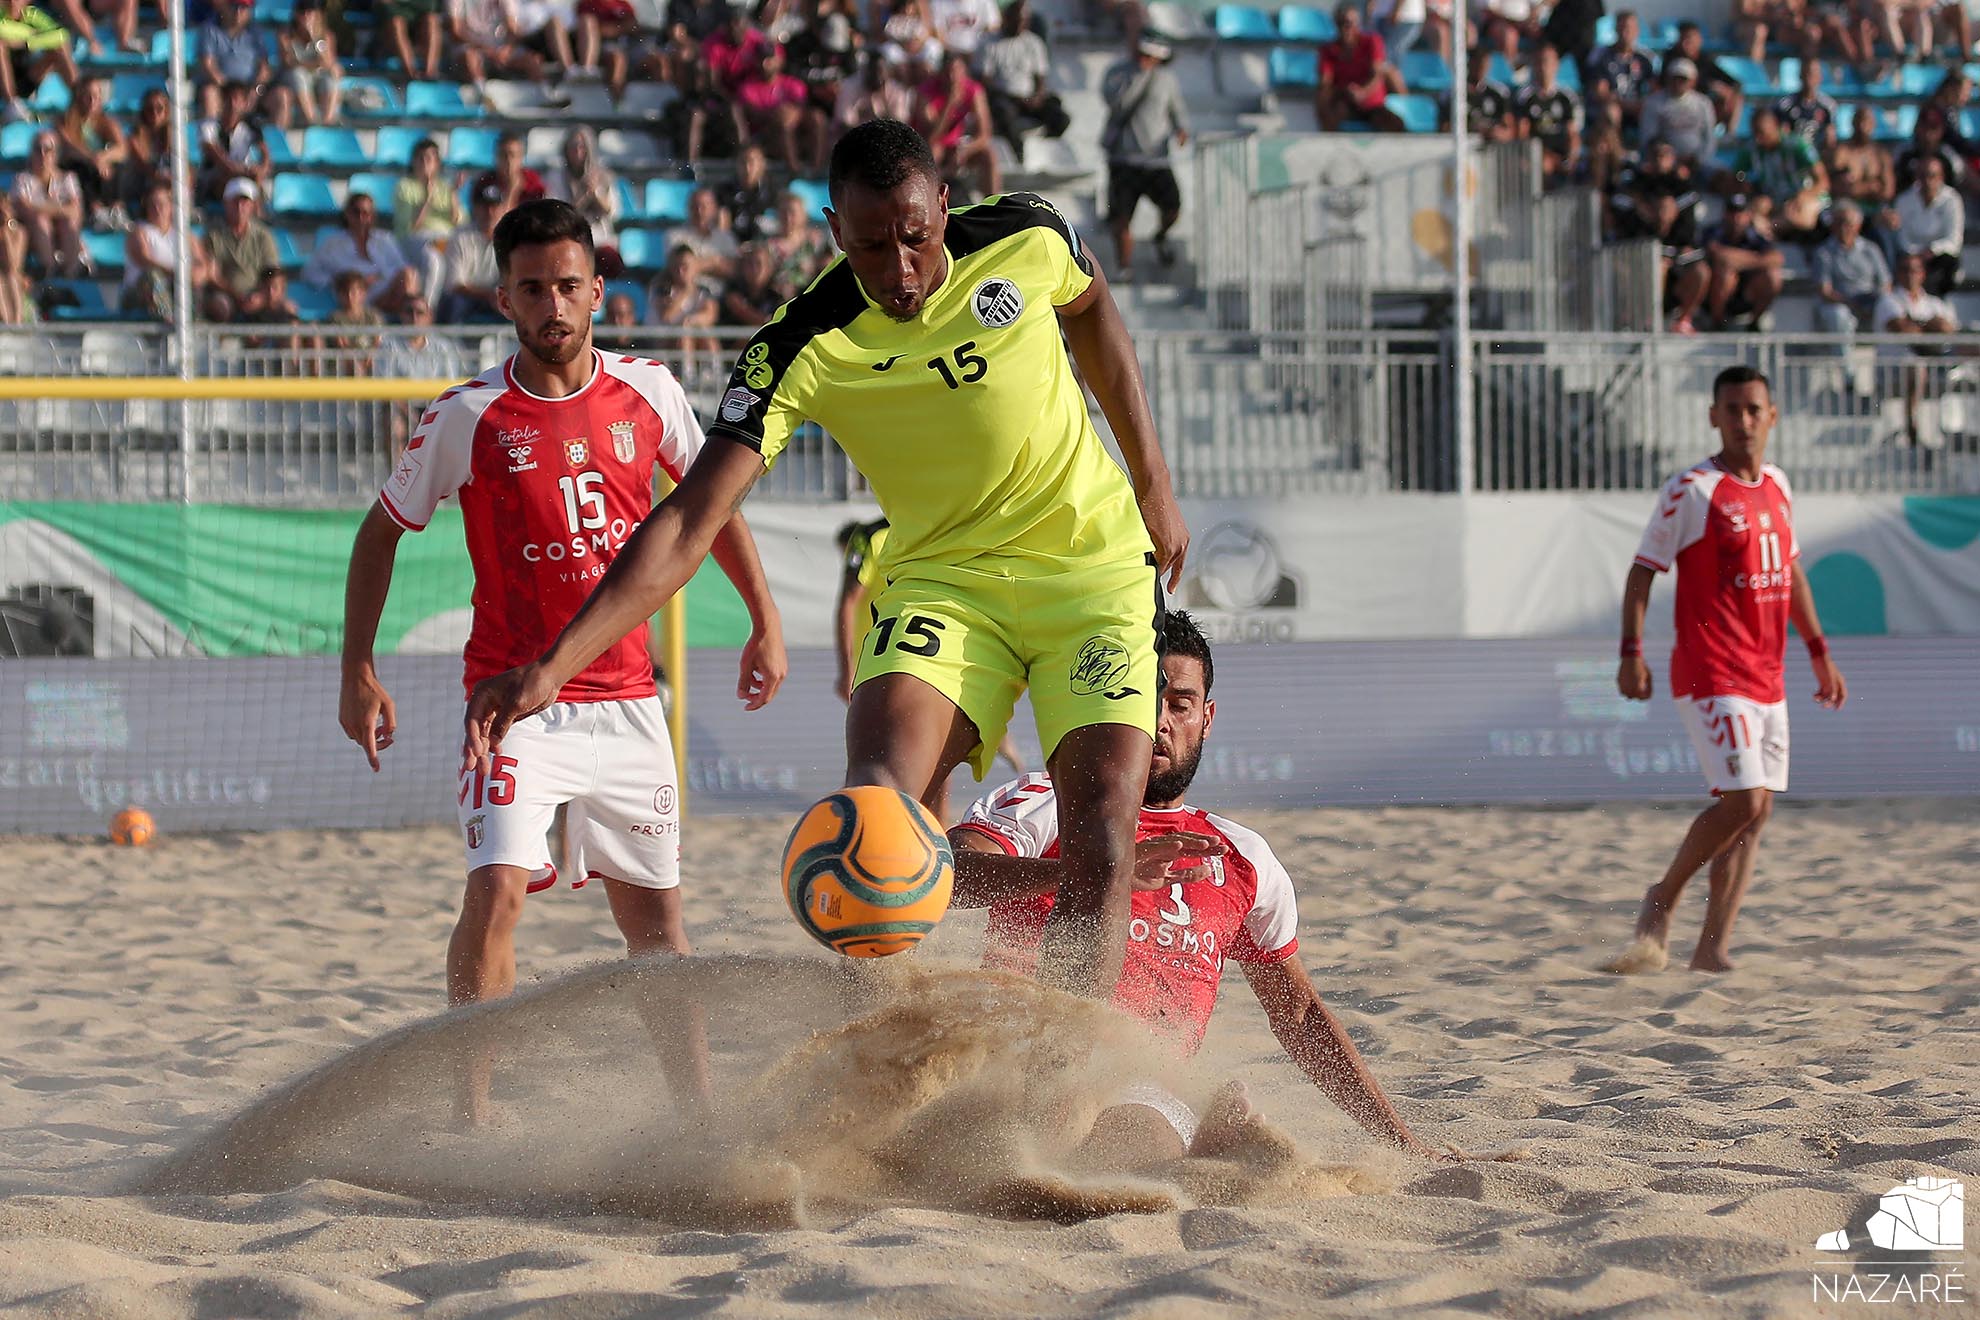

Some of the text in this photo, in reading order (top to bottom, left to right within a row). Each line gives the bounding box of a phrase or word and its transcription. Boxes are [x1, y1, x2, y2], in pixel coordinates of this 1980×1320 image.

[928, 341, 988, 389] 15
[558, 471, 608, 535] 15
[560, 562, 607, 583] VIAGE
[1759, 532, 1782, 573] 11
[130, 622, 344, 657] NAZAR
[874, 615, 946, 657] 15
[1724, 714, 1750, 749] 11
[473, 755, 519, 809] 15
[630, 821, 678, 835] PROTE
